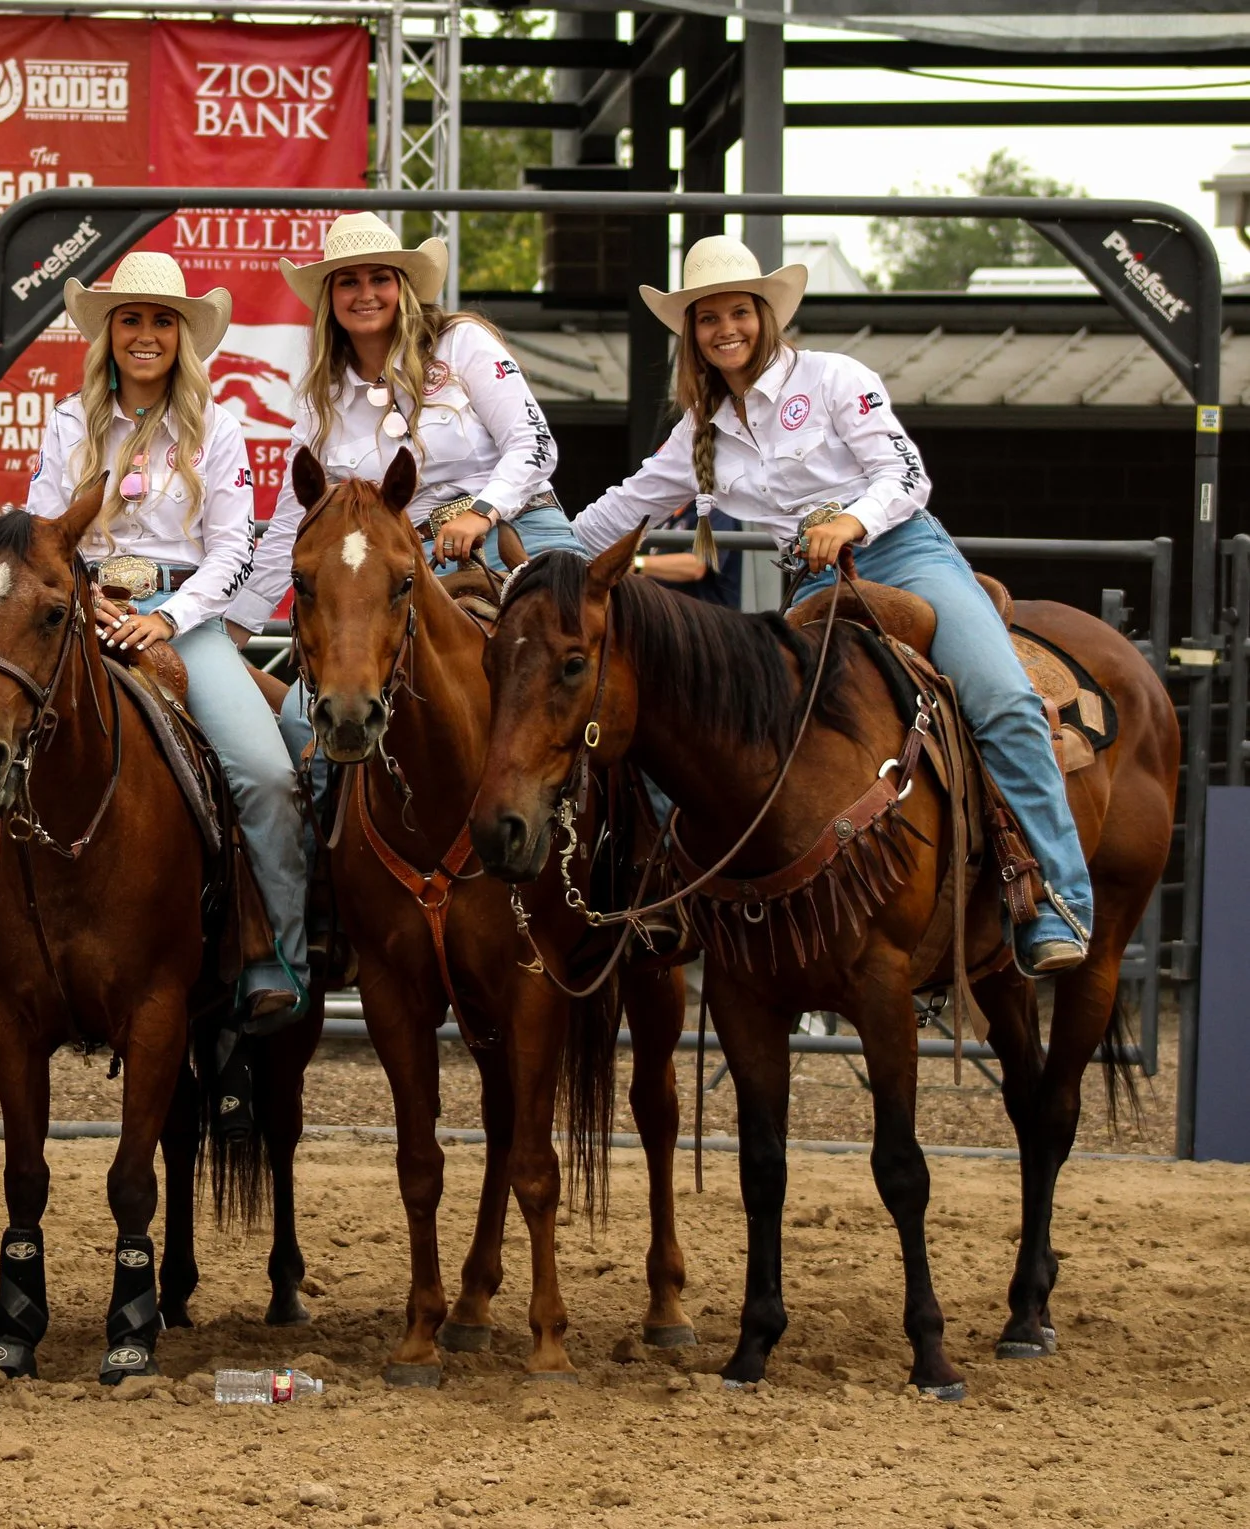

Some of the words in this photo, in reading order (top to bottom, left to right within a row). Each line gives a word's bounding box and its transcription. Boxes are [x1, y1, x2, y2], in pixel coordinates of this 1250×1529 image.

[27, 76, 128, 108] RODEO
[196, 63, 333, 100] ZIONS
[195, 101, 330, 140] BANK
[11, 222, 97, 301] Priefert
[179, 259, 232, 271] AMILY
[1102, 230, 1185, 318] Priefert
[5, 459, 21, 471] IN
